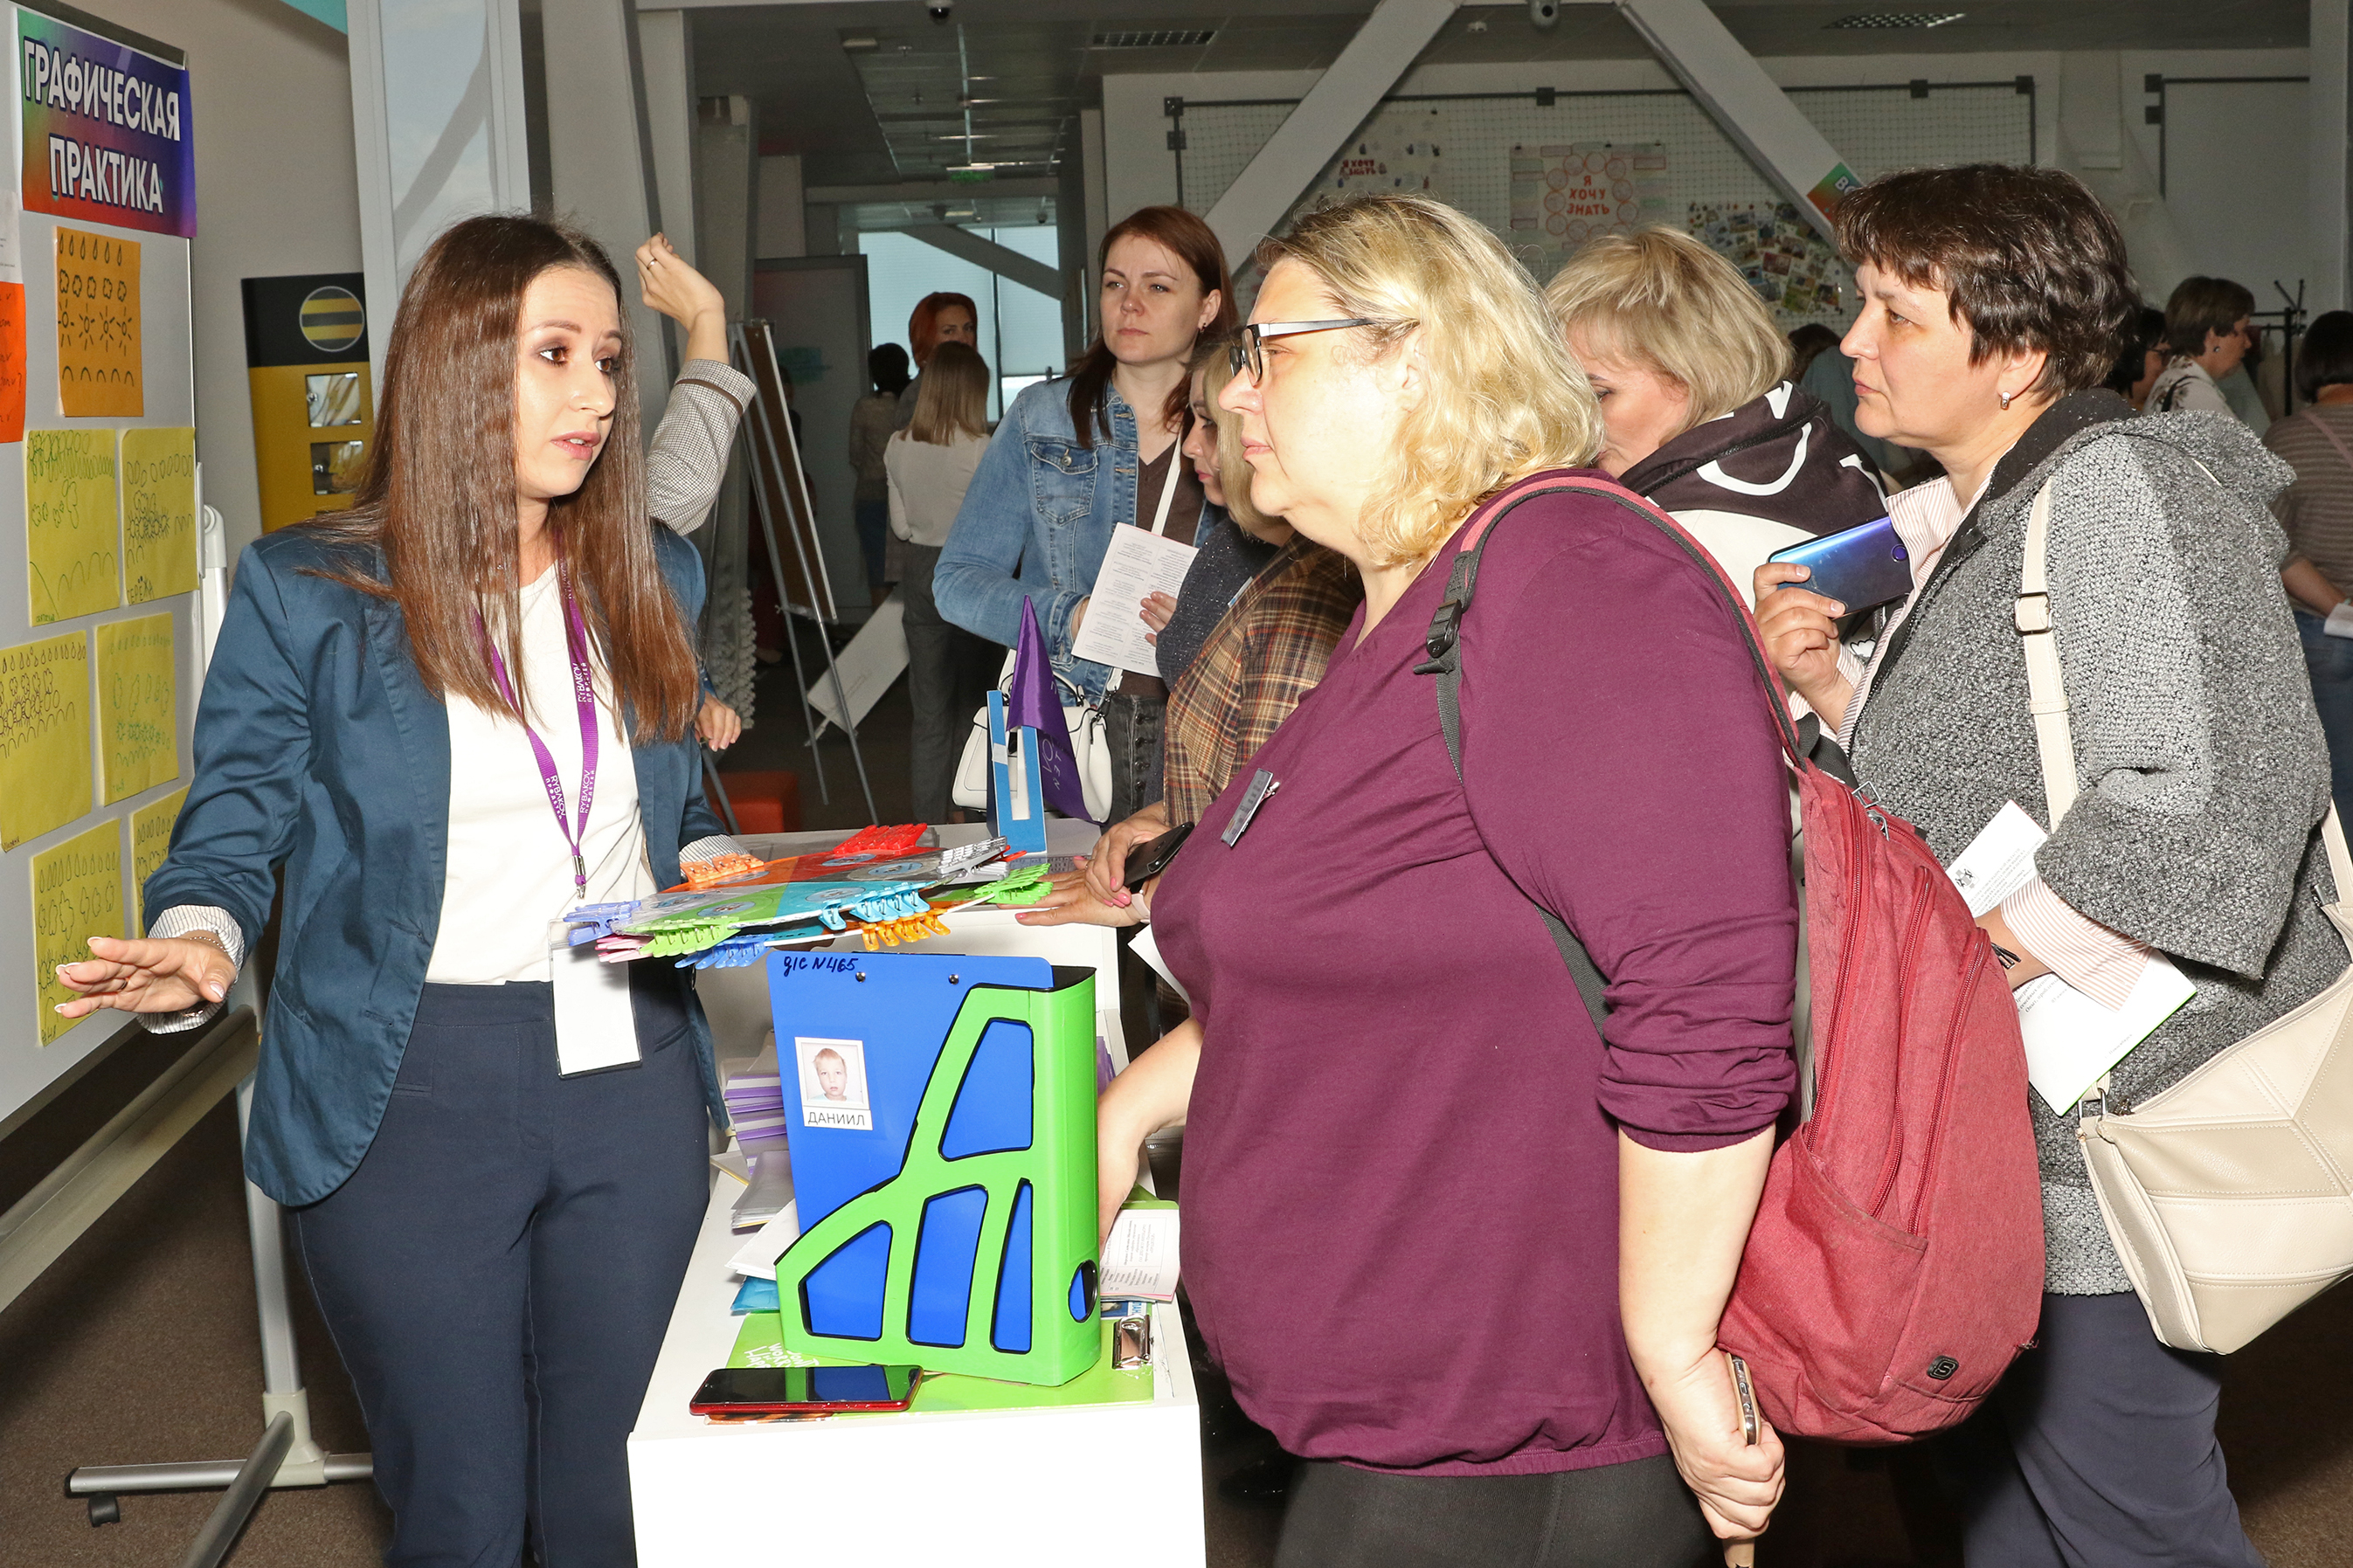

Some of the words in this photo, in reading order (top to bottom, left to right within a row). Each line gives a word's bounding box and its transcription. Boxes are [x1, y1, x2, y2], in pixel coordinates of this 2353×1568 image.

[23, 38, 181, 142] ГРАФИЧЕСКАЯ
[49, 135, 164, 214] ПРАКТИКА
[1583, 175, 1592, 186] Я
[1568, 188, 1607, 200] ХОЧУ
[1567, 203, 1610, 216] ЗНАТЬ
[550, 775, 566, 816] RYBAKOV
[579, 769, 591, 813] RYBAKOV
[807, 1111, 866, 1127] ДАНИИЛ
